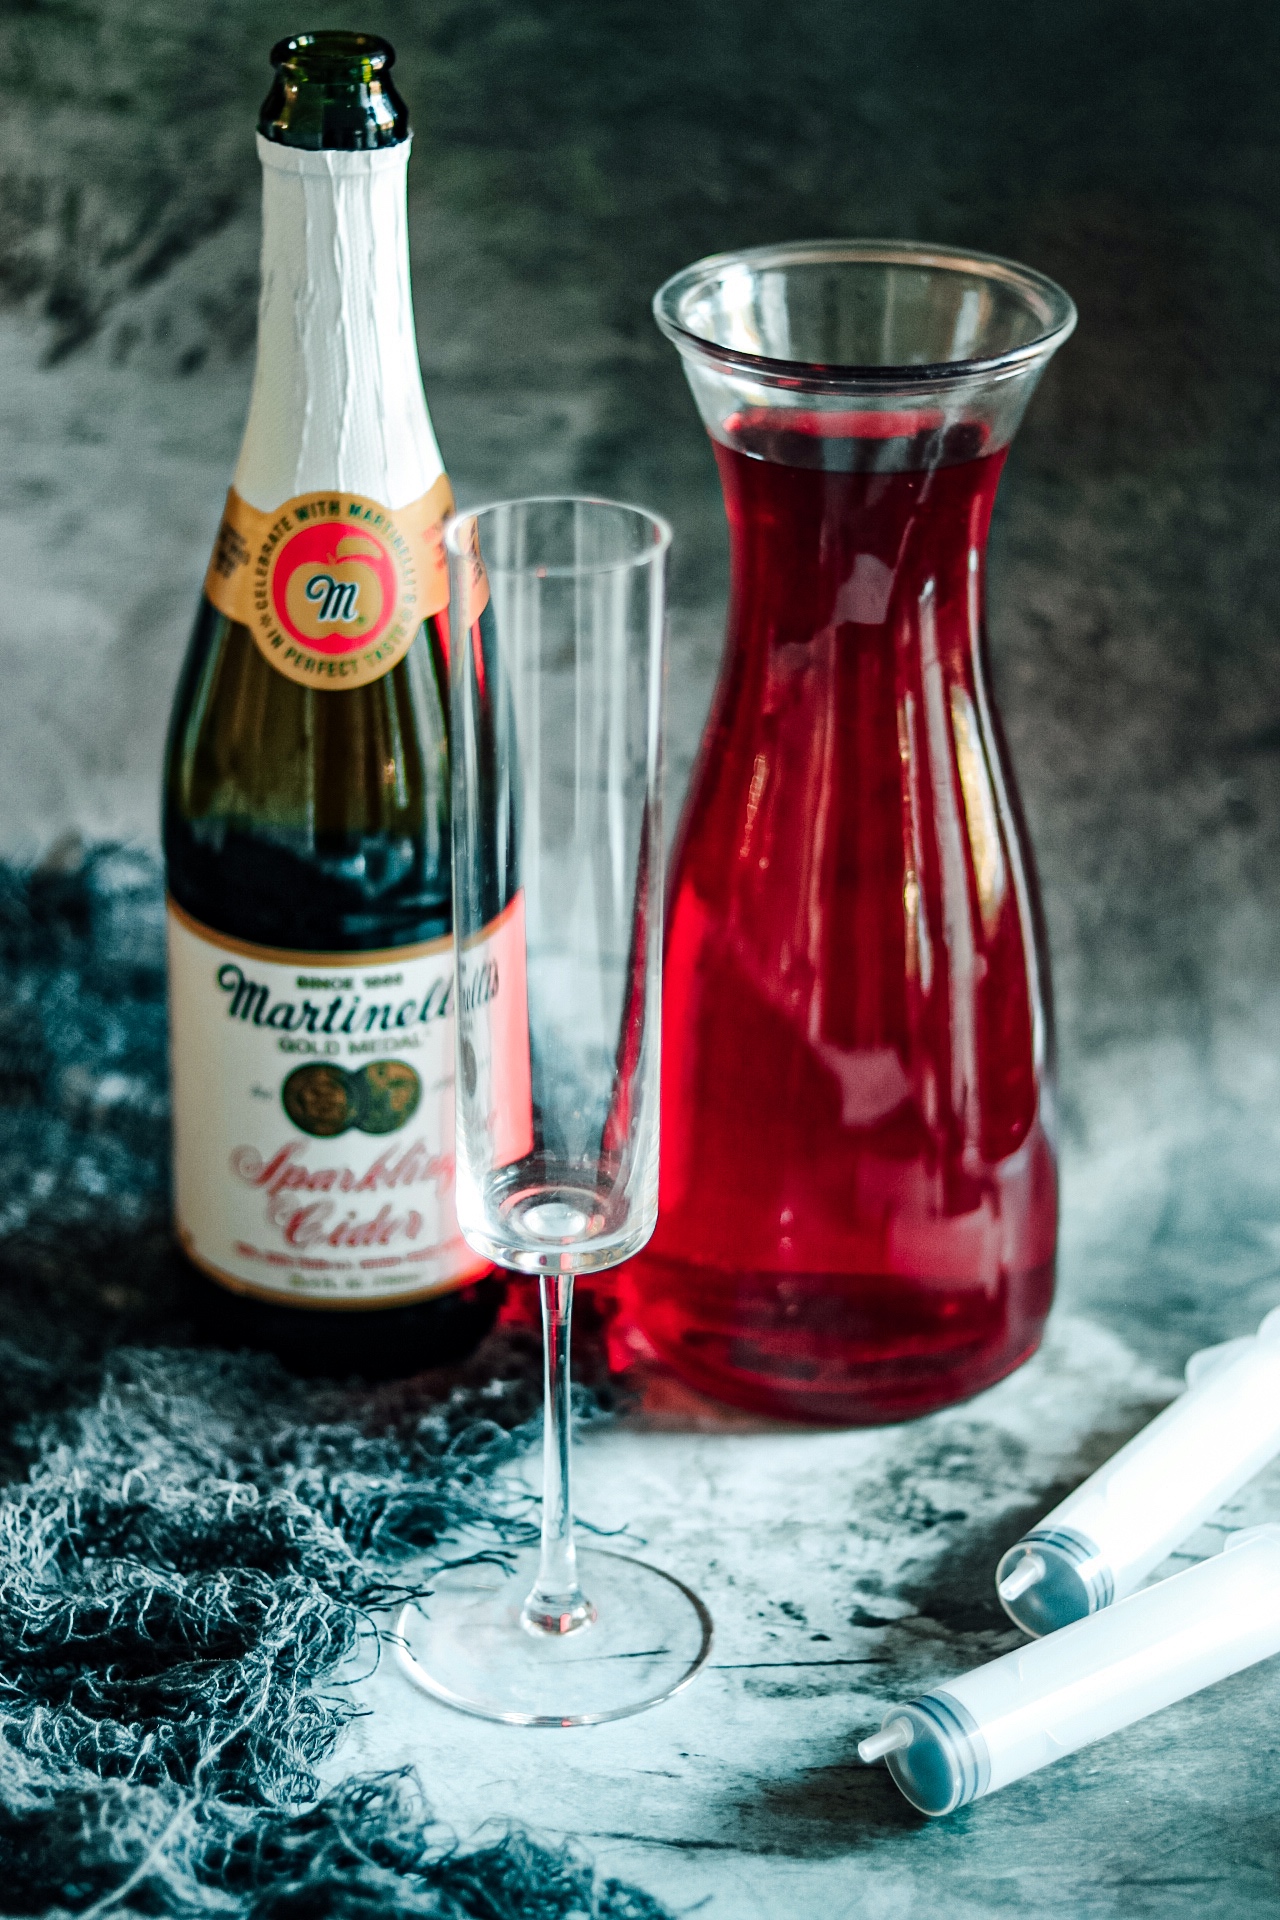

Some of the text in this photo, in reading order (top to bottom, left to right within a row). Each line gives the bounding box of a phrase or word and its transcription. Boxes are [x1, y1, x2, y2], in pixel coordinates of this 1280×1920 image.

[294, 500, 341, 522] WITH
[284, 647, 360, 678] PERFECT
[278, 1035, 421, 1056] GOLD MEDAL
